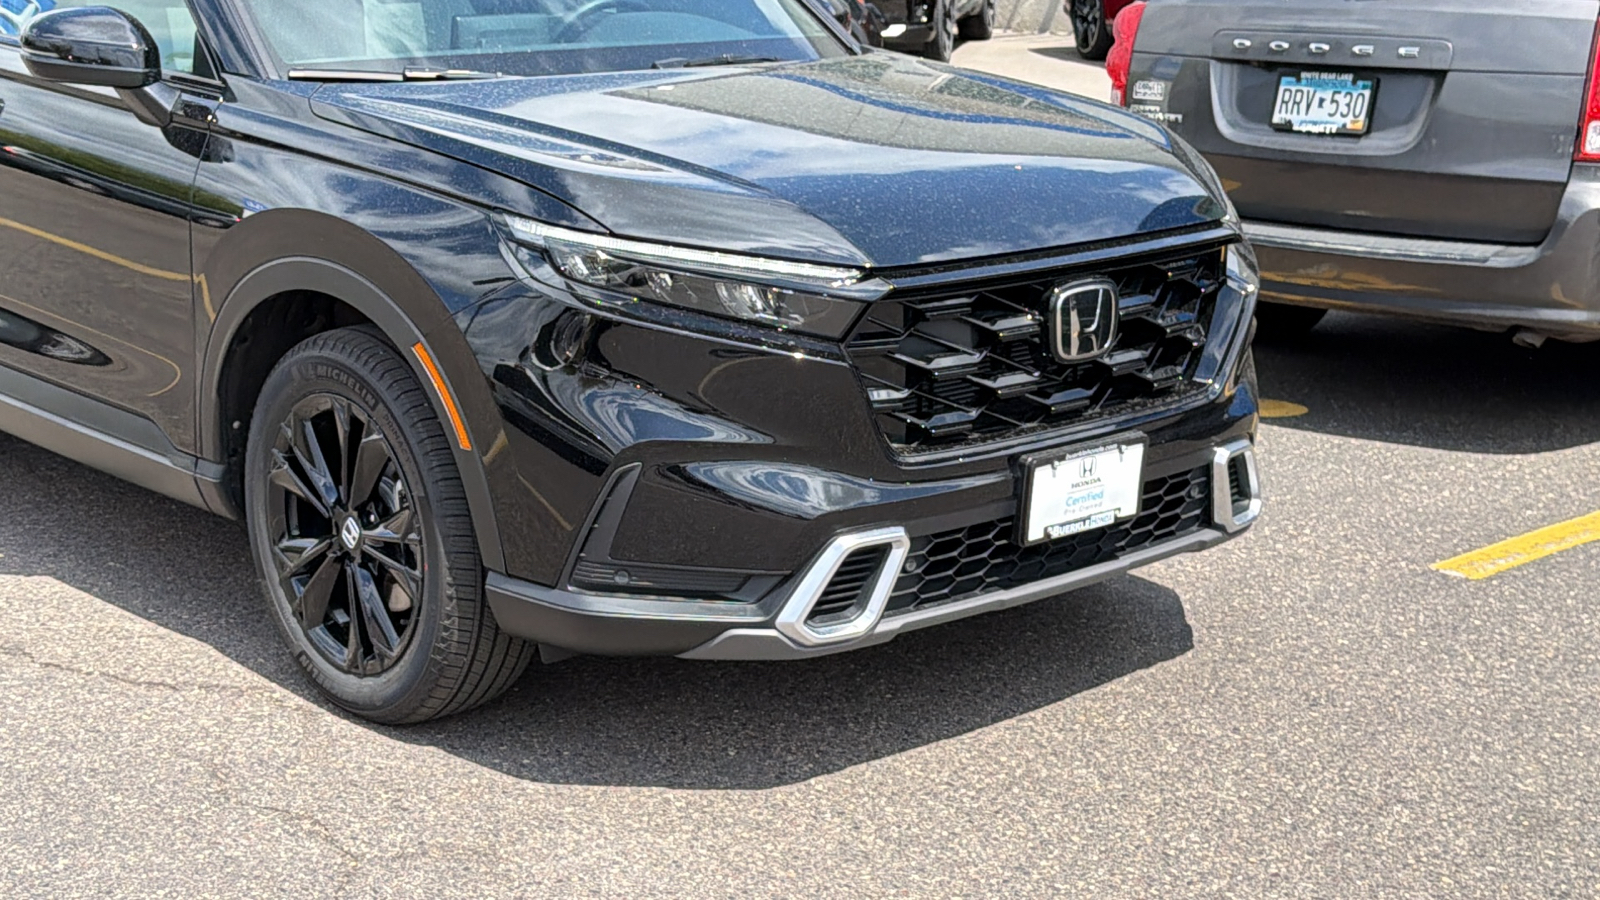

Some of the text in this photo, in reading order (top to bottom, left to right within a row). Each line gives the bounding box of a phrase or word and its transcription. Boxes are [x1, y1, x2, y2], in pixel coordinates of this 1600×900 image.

[1233, 38, 1420, 58] DODGE
[1278, 88, 1365, 119] RRV 530
[315, 363, 377, 409] MICHELIN
[1071, 477, 1102, 489] HONDA
[1066, 491, 1104, 507] Certified
